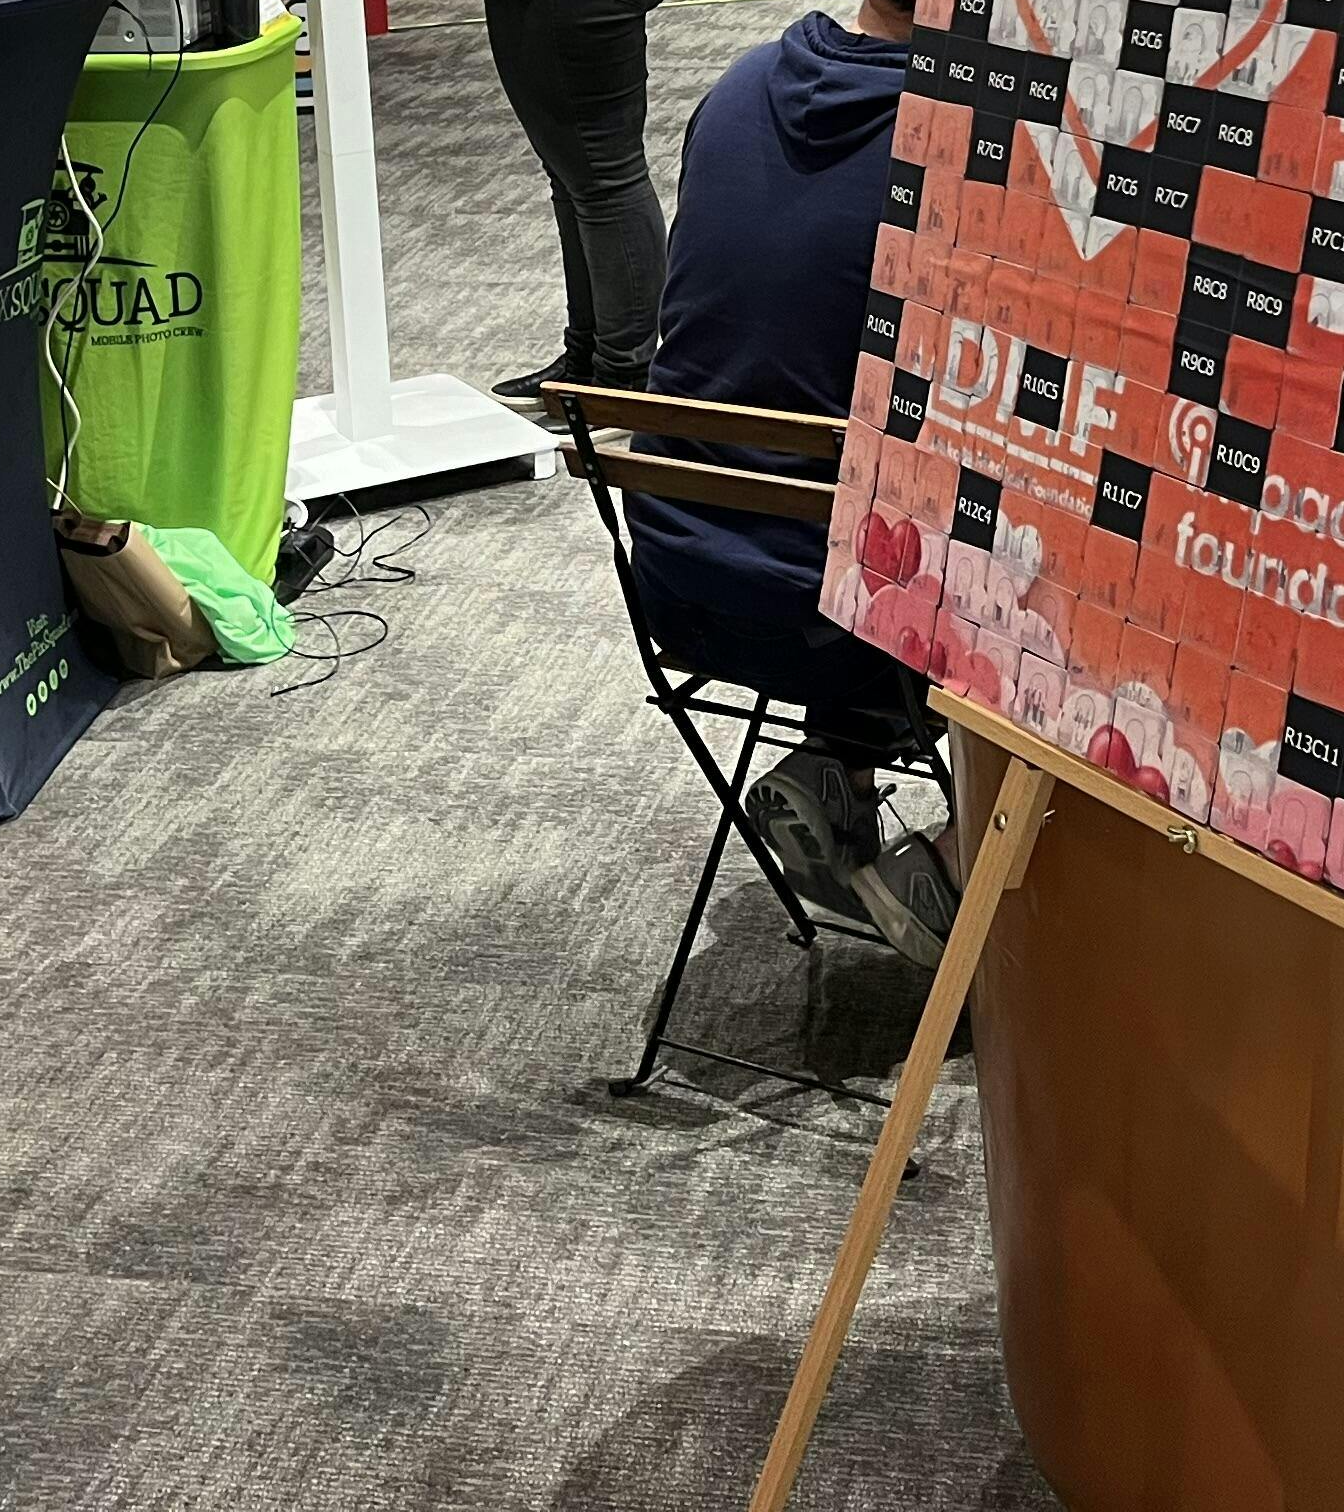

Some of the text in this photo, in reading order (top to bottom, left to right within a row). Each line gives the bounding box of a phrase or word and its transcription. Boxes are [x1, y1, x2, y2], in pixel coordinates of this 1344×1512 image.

[1130, 28, 1163, 50] R5C6
[911, 53, 1058, 102] R6C1 R6C2 R6C3 R6C4
[1166, 112, 1254, 147] R6C7 R6C8
[976, 139, 1004, 161] R7C3
[890, 184, 914, 206] R8C1
[1106, 173, 1189, 209] R7C6 R7C7
[1192, 275, 1283, 316] R8C8 R8C9
[91, 326, 206, 347] MOBILE PHOTO CREW
[866, 314, 895, 339] R10C1
[1180, 350, 1216, 377] R9C8
[1022, 373, 1060, 400] R10C5
[891, 394, 923, 421] R11C2
[1216, 444, 1261, 474] R10C9
[1102, 481, 1143, 510] R11C7
[958, 496, 992, 525] R12C4
[1284, 726, 1339, 767] R13C11
